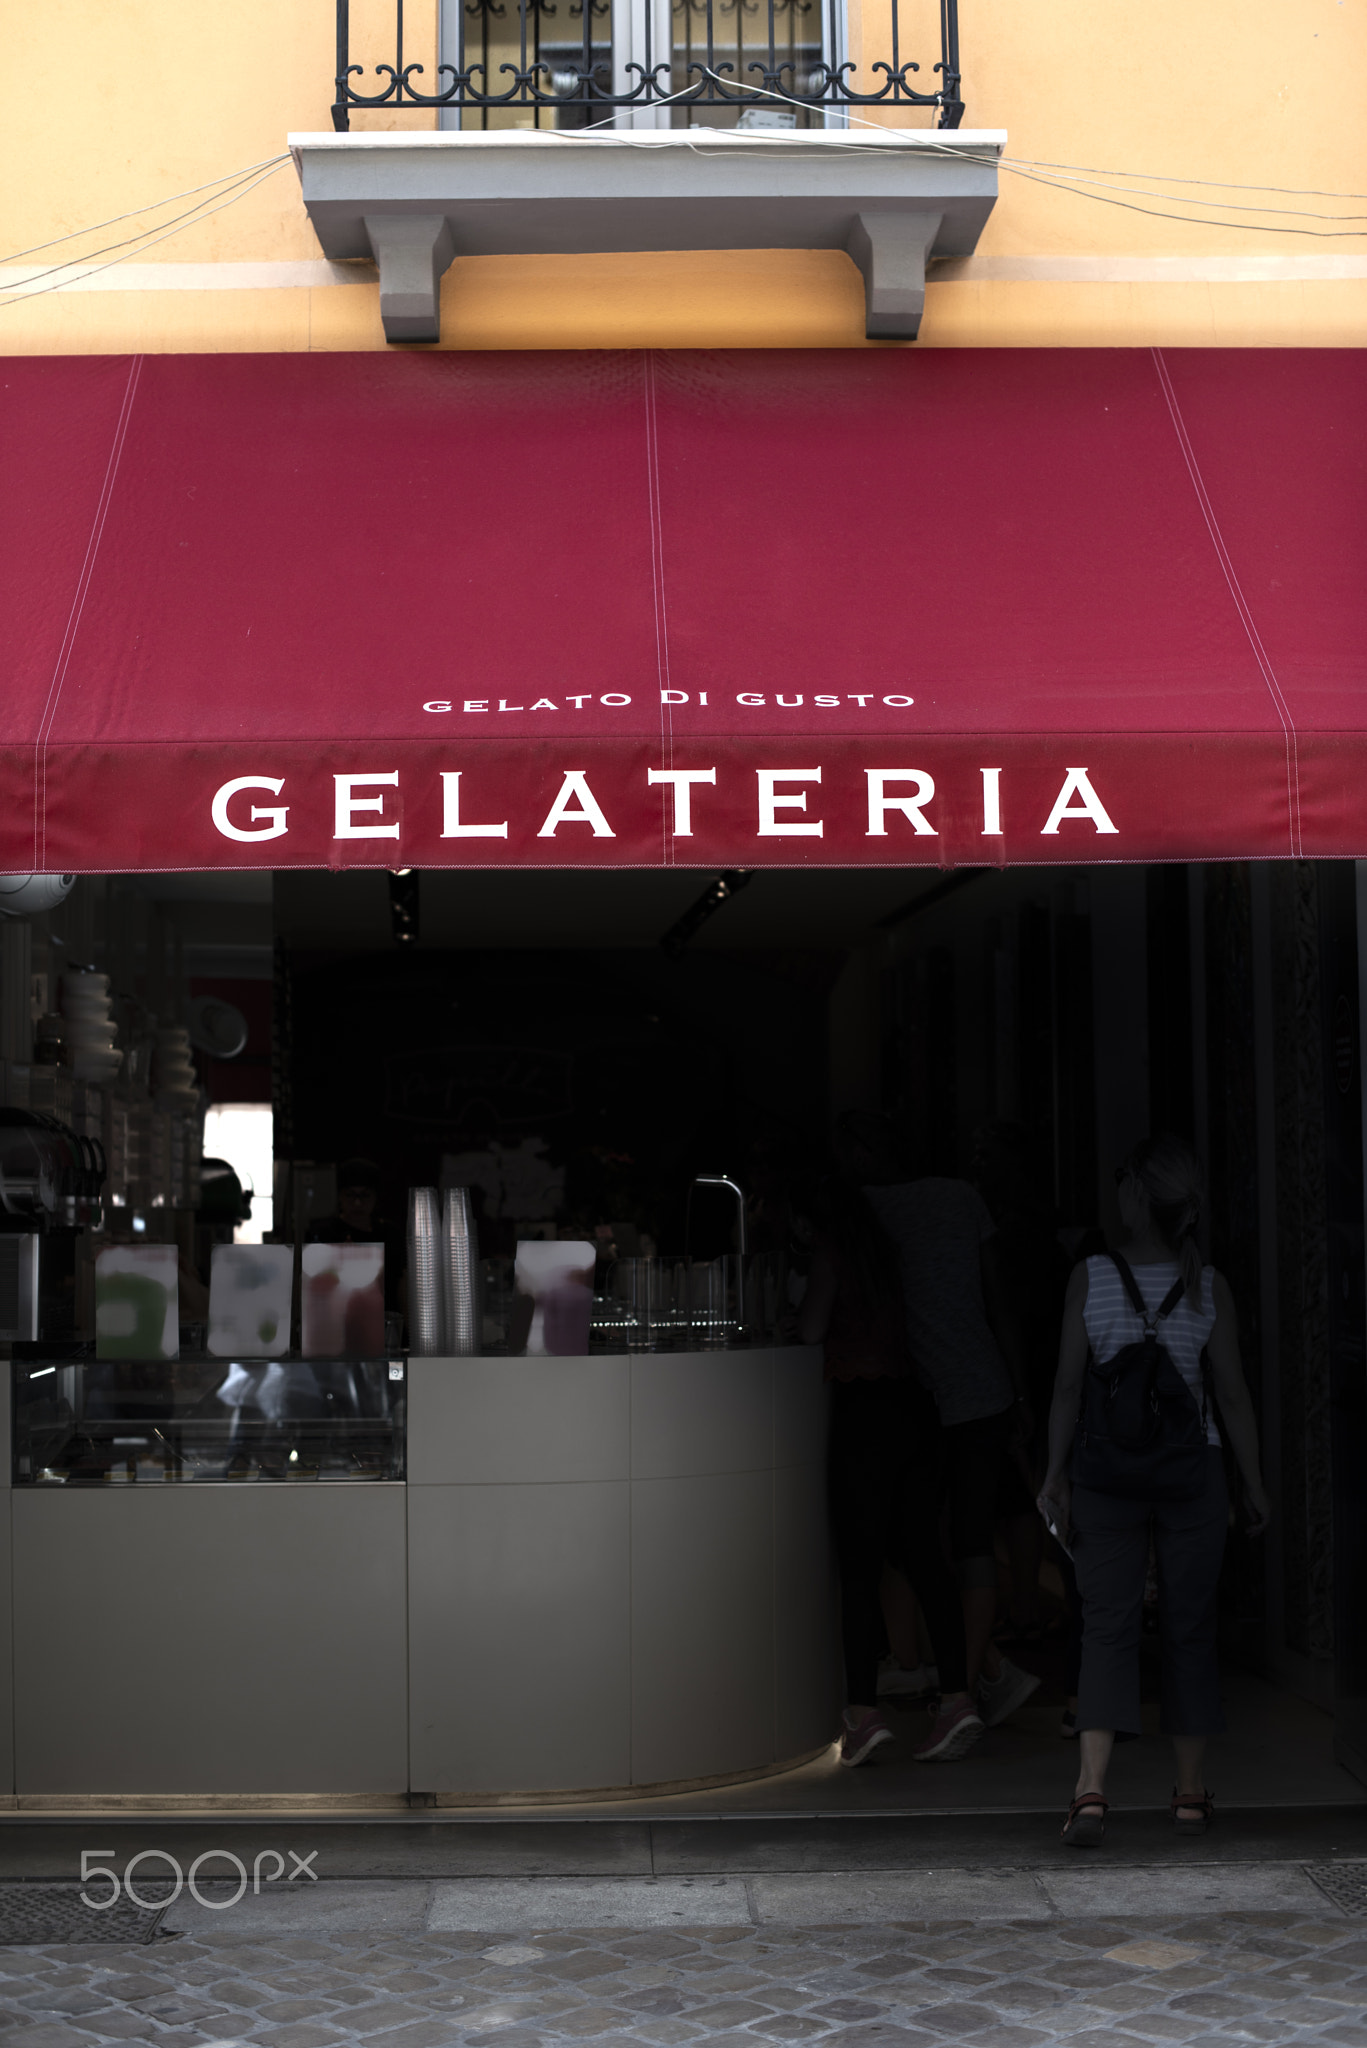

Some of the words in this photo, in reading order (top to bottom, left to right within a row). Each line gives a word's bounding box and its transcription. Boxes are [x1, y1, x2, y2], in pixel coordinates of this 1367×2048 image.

[422, 692, 632, 713] GELATO
[659, 689, 709, 707] DI
[735, 692, 915, 708] GUSTO
[211, 765, 1120, 843] GELATERIA
